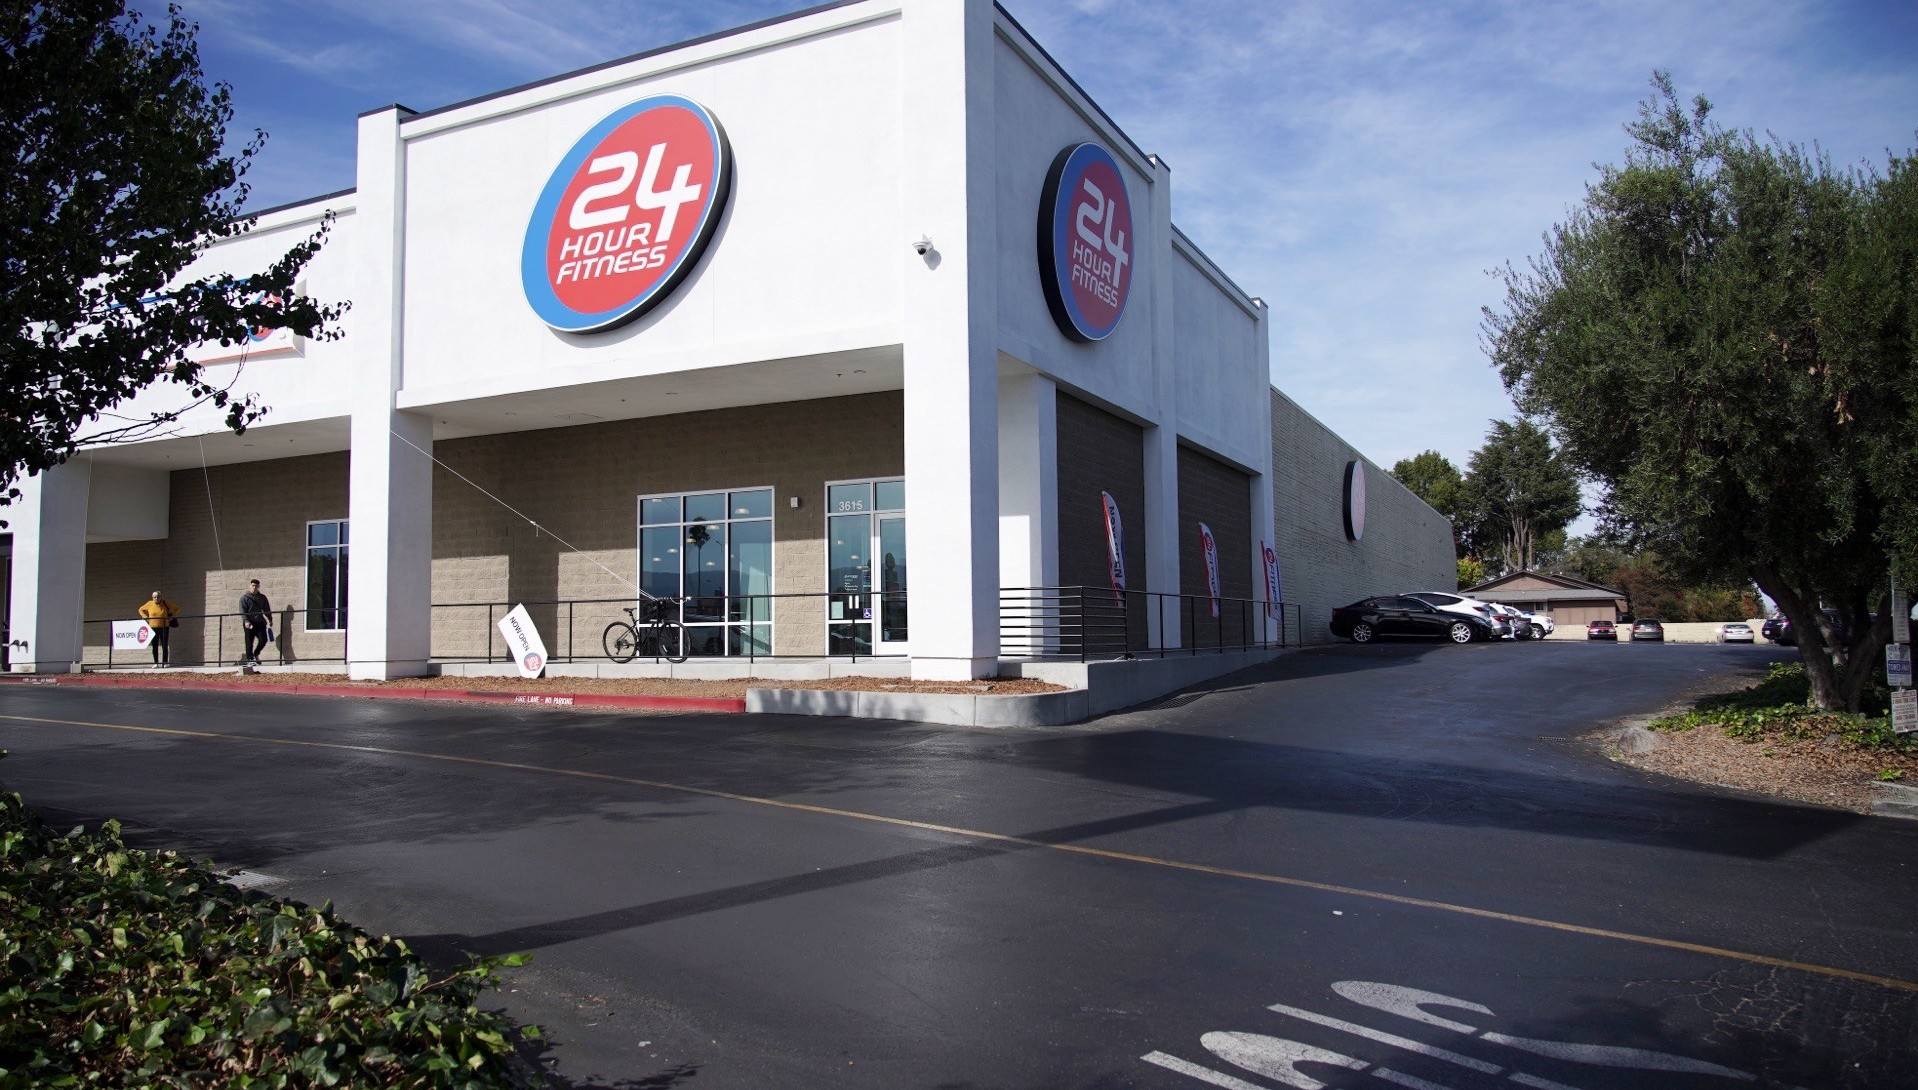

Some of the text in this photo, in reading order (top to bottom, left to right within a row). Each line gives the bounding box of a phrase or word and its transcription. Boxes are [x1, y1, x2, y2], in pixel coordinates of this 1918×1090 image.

[569, 142, 702, 243] 24
[559, 222, 652, 260] HOUR
[1076, 178, 1128, 289] 24
[556, 245, 668, 285] FITNESS
[1072, 241, 1111, 283] HOUR
[1072, 264, 1119, 308] FITNESS
[838, 500, 863, 511] 3615
[509, 616, 531, 652] NOW OPEN
[515, 695, 526, 703] FIRE
[527, 695, 540, 703] LANE
[553, 697, 573, 705] PARKING
